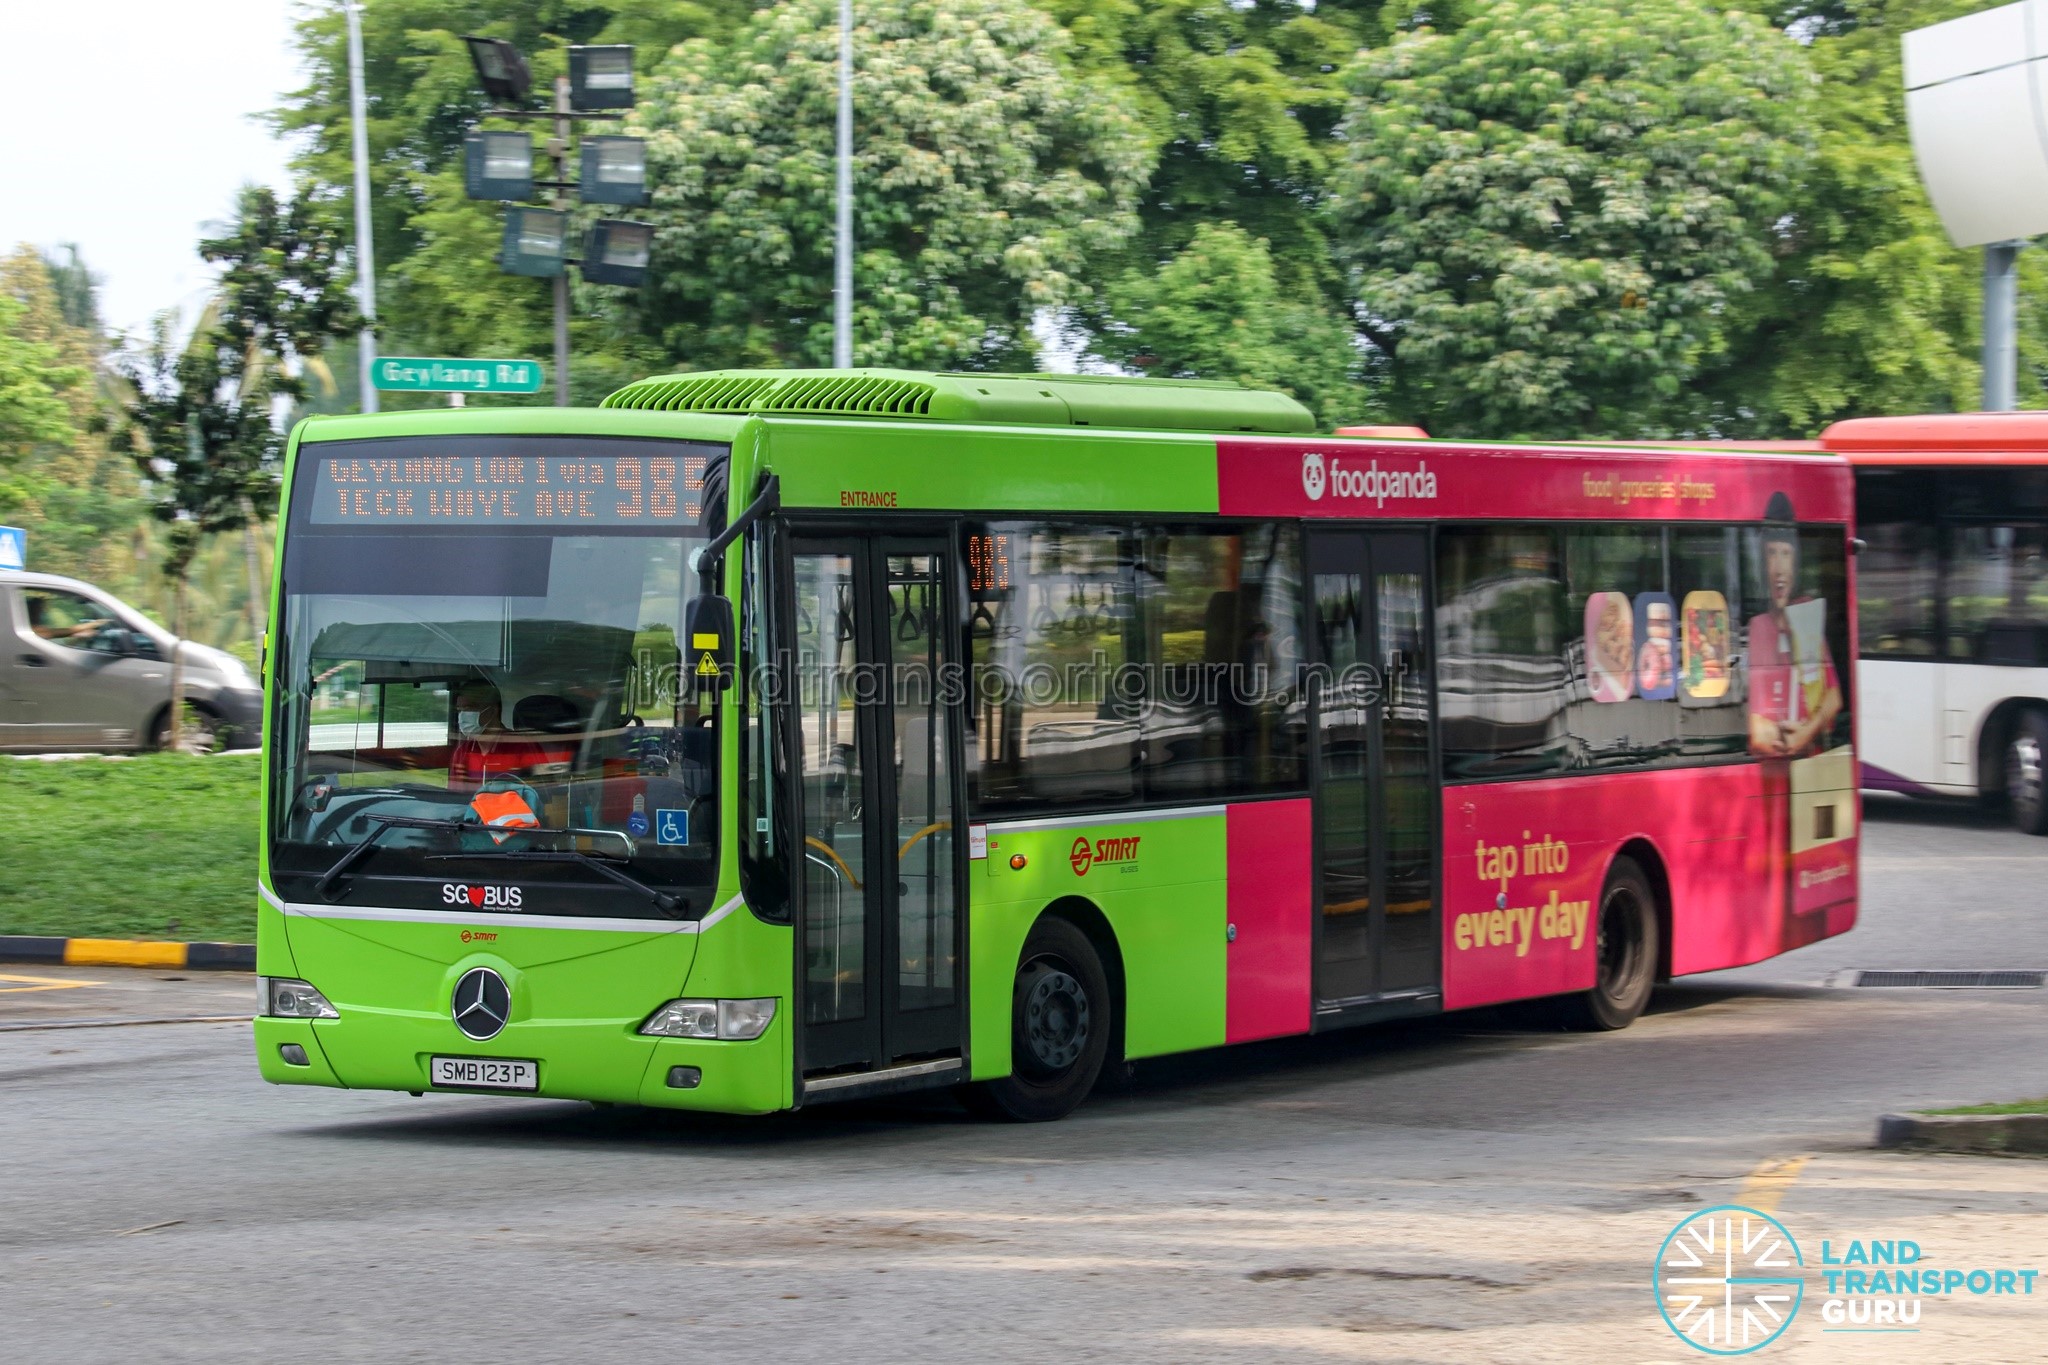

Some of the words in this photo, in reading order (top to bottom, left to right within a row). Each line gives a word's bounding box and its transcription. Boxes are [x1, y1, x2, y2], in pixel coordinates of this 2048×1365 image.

[382, 361, 490, 388] Geylang
[495, 360, 529, 384] Rd
[330, 456, 464, 484] GEYLANG
[474, 456, 524, 484] LOR
[536, 456, 549, 484] 1
[559, 457, 605, 484] via
[1330, 458, 1437, 508] foodpanda
[615, 456, 707, 518] 985
[840, 491, 898, 508] ENTRANCE
[337, 489, 413, 517] TECK
[430, 489, 519, 517] WHYE
[535, 489, 596, 518] AVE
[970, 536, 1009, 590] 985
[1094, 836, 1141, 863] SMRT
[1475, 838, 1519, 893] tap
[1523, 830, 1568, 876] into
[472, 932, 498, 941] SMRT
[1454, 902, 1535, 958] every
[1539, 890, 1590, 950] day
[443, 1062, 525, 1083] SMB123P
